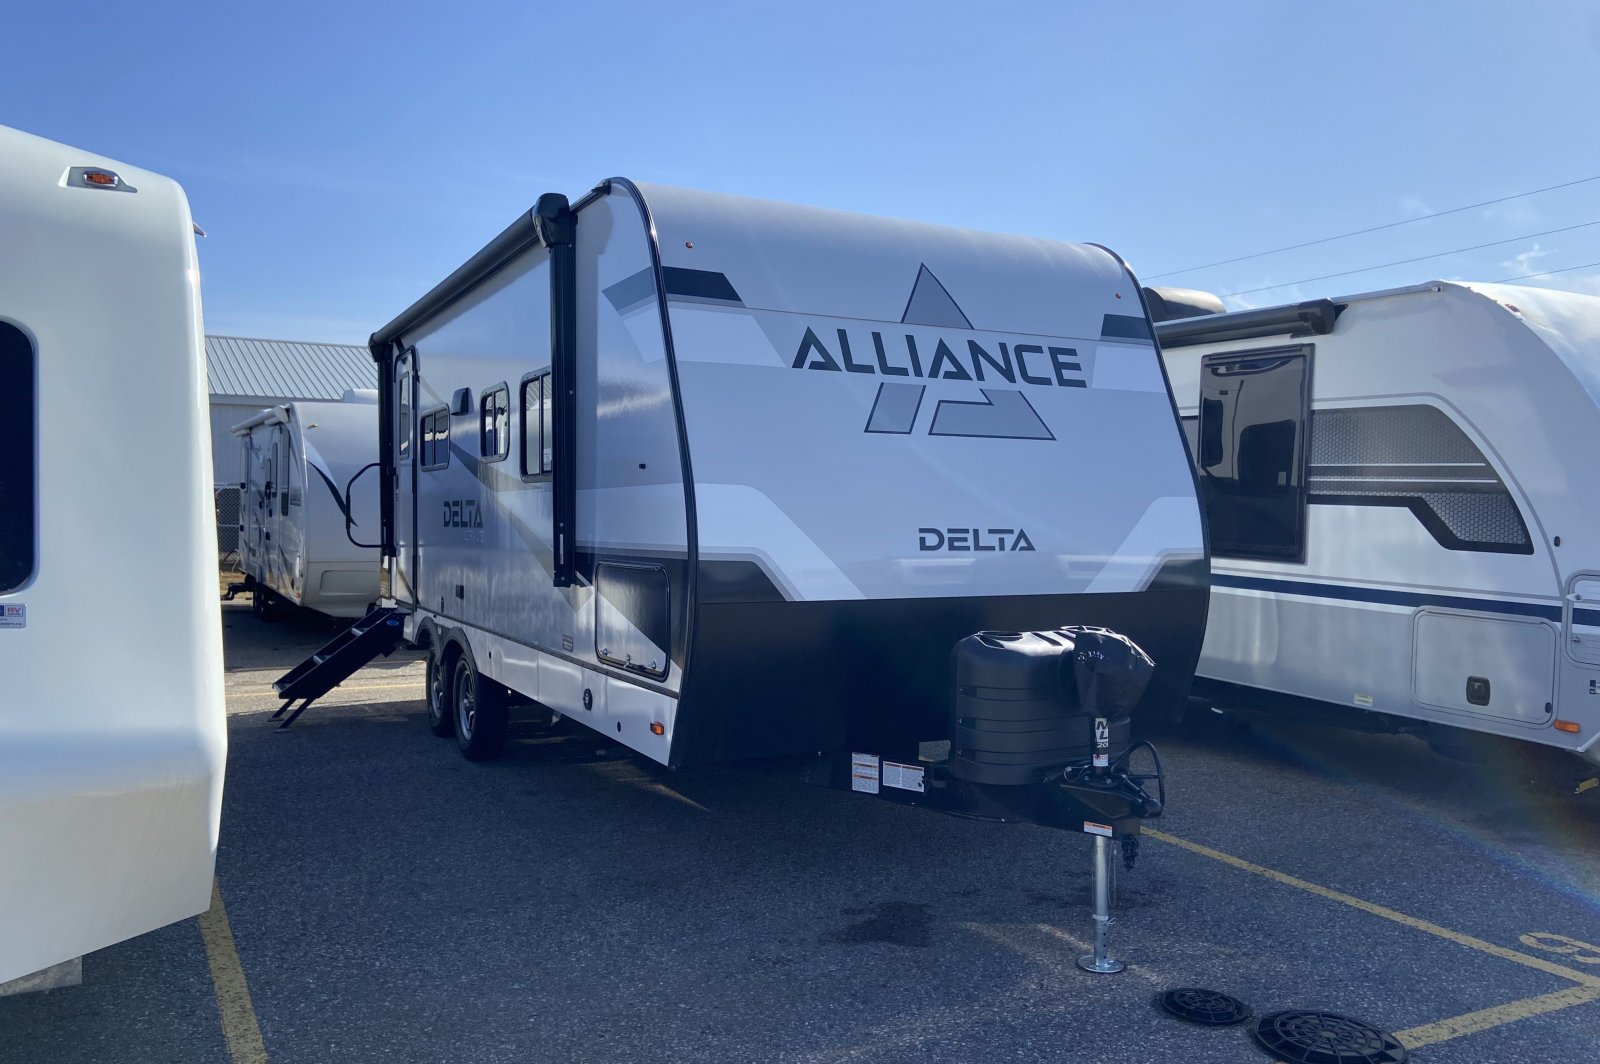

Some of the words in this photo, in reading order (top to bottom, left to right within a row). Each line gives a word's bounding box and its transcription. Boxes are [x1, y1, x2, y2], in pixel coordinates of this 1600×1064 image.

[791, 326, 1087, 388] ALLIANCE
[443, 499, 484, 528] DELTA
[918, 527, 1036, 552] DELTA
